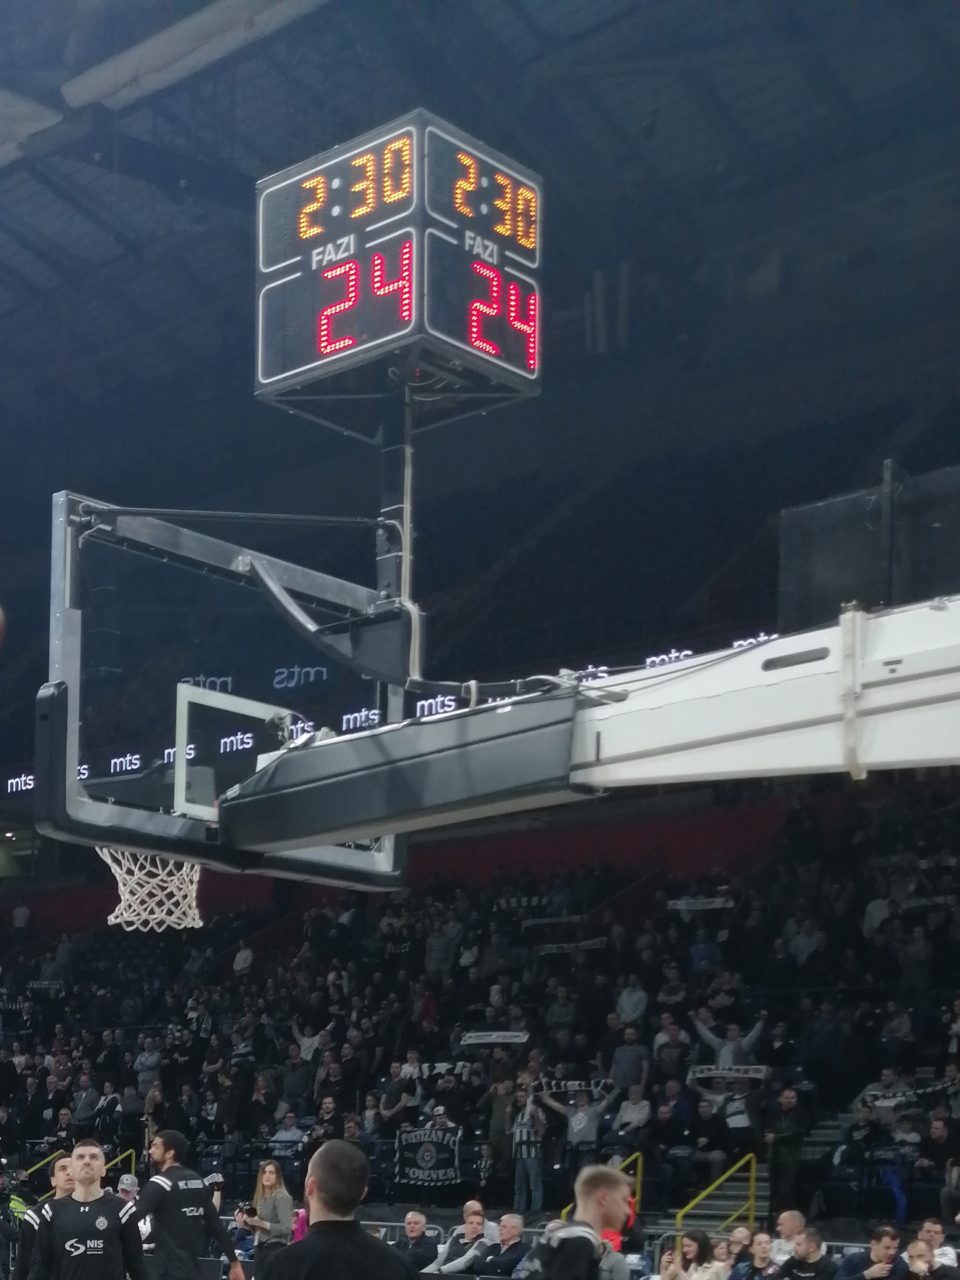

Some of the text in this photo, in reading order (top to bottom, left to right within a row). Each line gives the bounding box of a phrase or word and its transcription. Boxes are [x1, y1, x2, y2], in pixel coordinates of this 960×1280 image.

[297, 136, 413, 240] 2:30
[453, 152, 537, 249] 2:30
[312, 233, 356, 270] FAZI
[464, 230, 498, 265] FAZI
[319, 239, 414, 355] 24
[470, 259, 537, 369] 24
[416, 693, 457, 719] mts
[342, 708, 379, 732] mts
[164, 743, 195, 764] ms
[220, 731, 254, 754] mts
[110, 752, 141, 774] mts
[8, 774, 34, 793] mts
[86, 1239, 104, 1249] NIS
